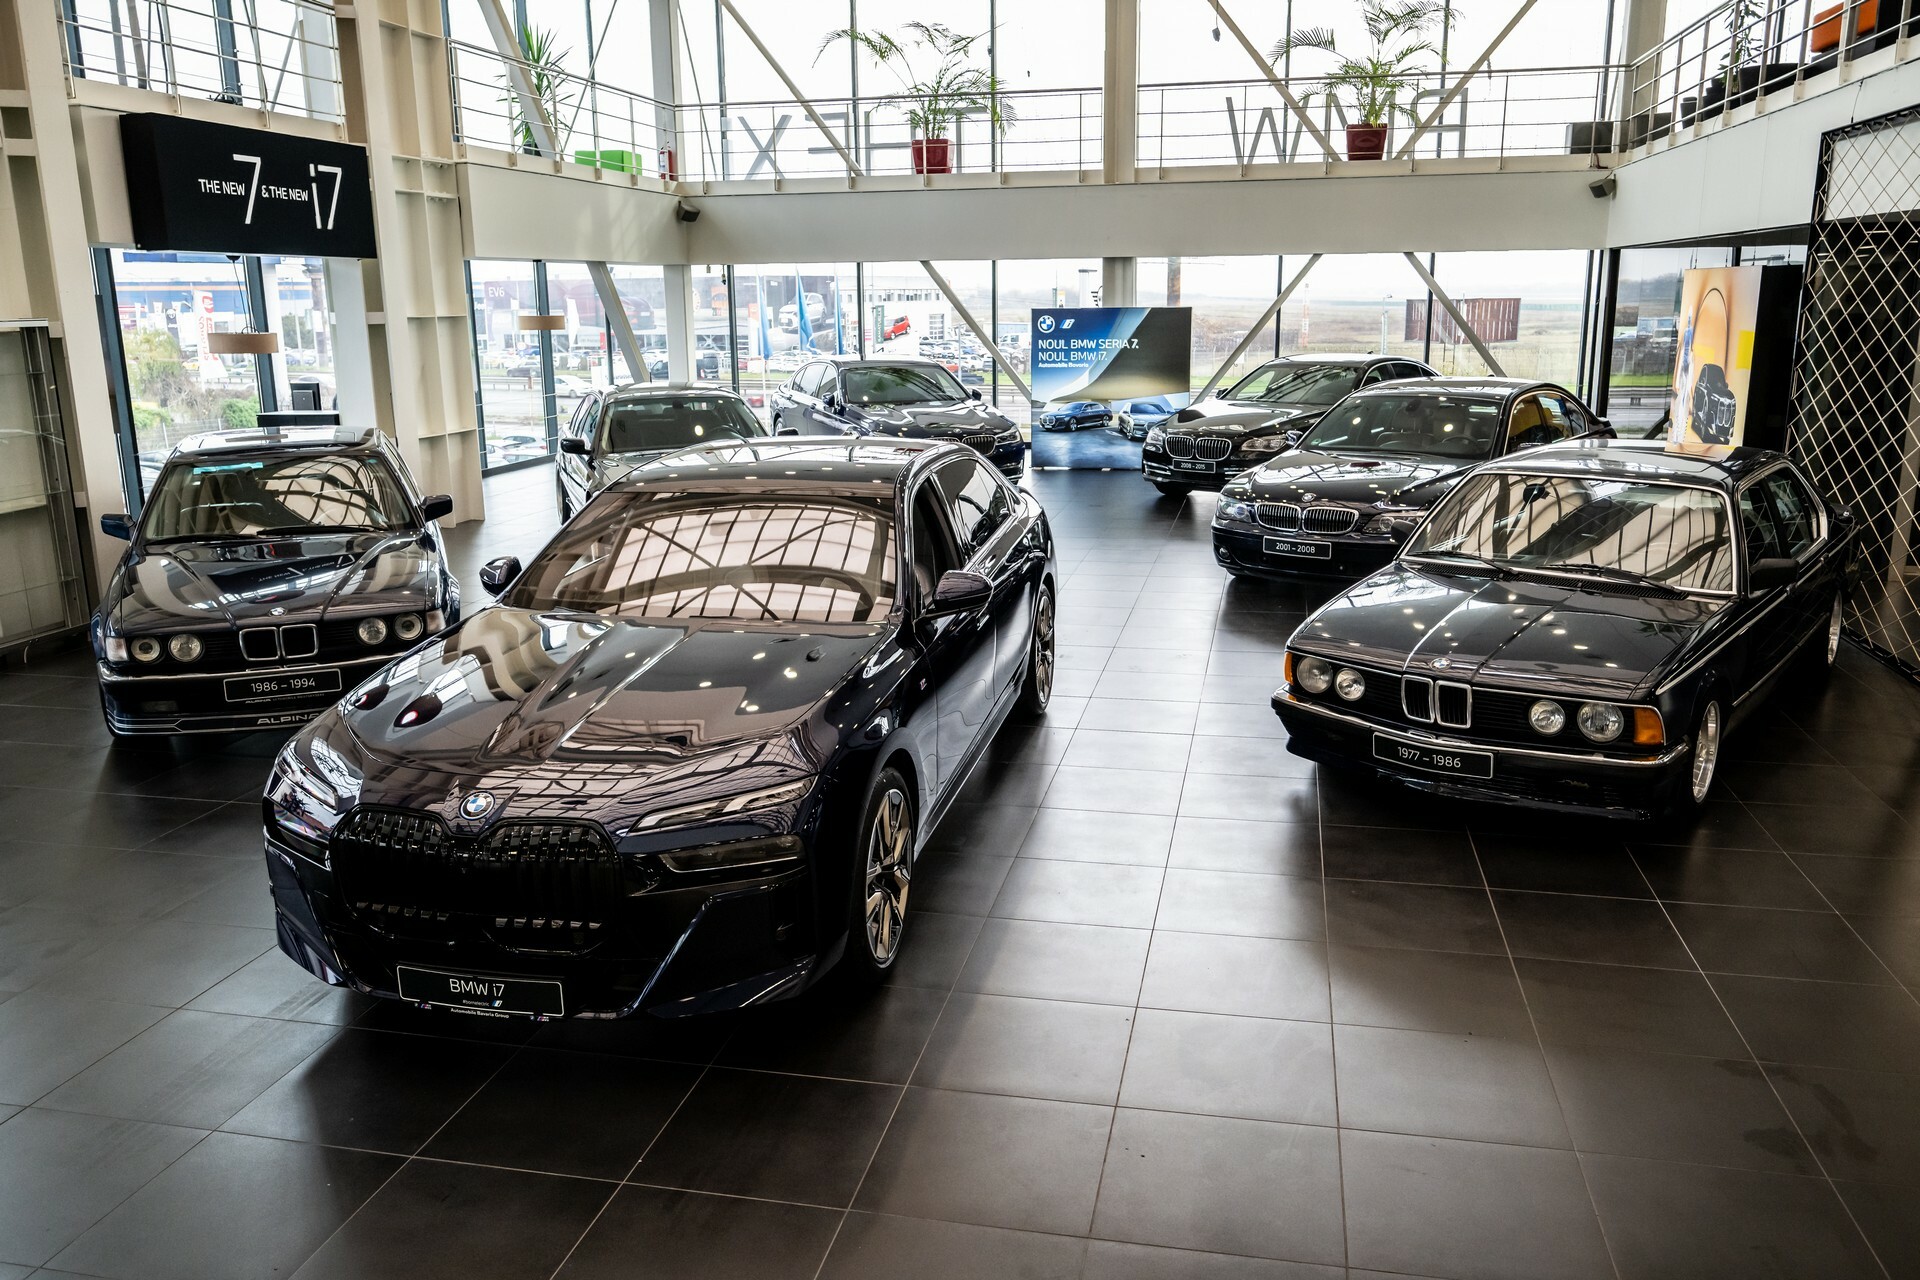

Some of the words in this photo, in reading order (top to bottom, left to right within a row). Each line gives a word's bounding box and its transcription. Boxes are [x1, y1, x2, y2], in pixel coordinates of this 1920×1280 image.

[198, 179, 221, 194] THE
[222, 181, 245, 196] NEW
[232, 153, 262, 225] 7
[261, 185, 269, 198] &
[268, 186, 288, 200] THE
[289, 188, 309, 202] NEW
[309, 163, 343, 230] i7
[488, 286, 505, 297] EV6
[1038, 339, 1068, 349] NOUL
[1070, 339, 1096, 349] BMW
[1098, 339, 1130, 349] SERIA
[1038, 351, 1068, 361] NOUL
[1070, 351, 1096, 361] BMW
[1276, 542, 1290, 550] 2001
[1297, 544, 1315, 553] 2008
[251, 681, 278, 692] 1986
[290, 678, 315, 689] 1994
[257, 713, 319, 725] ALPINA
[1398, 746, 1420, 760] 1977
[1432, 754, 1461, 768] 1986
[449, 978, 488, 996] BMW
[493, 983, 505, 997] i7
[450, 1007, 477, 1015] Automobile
